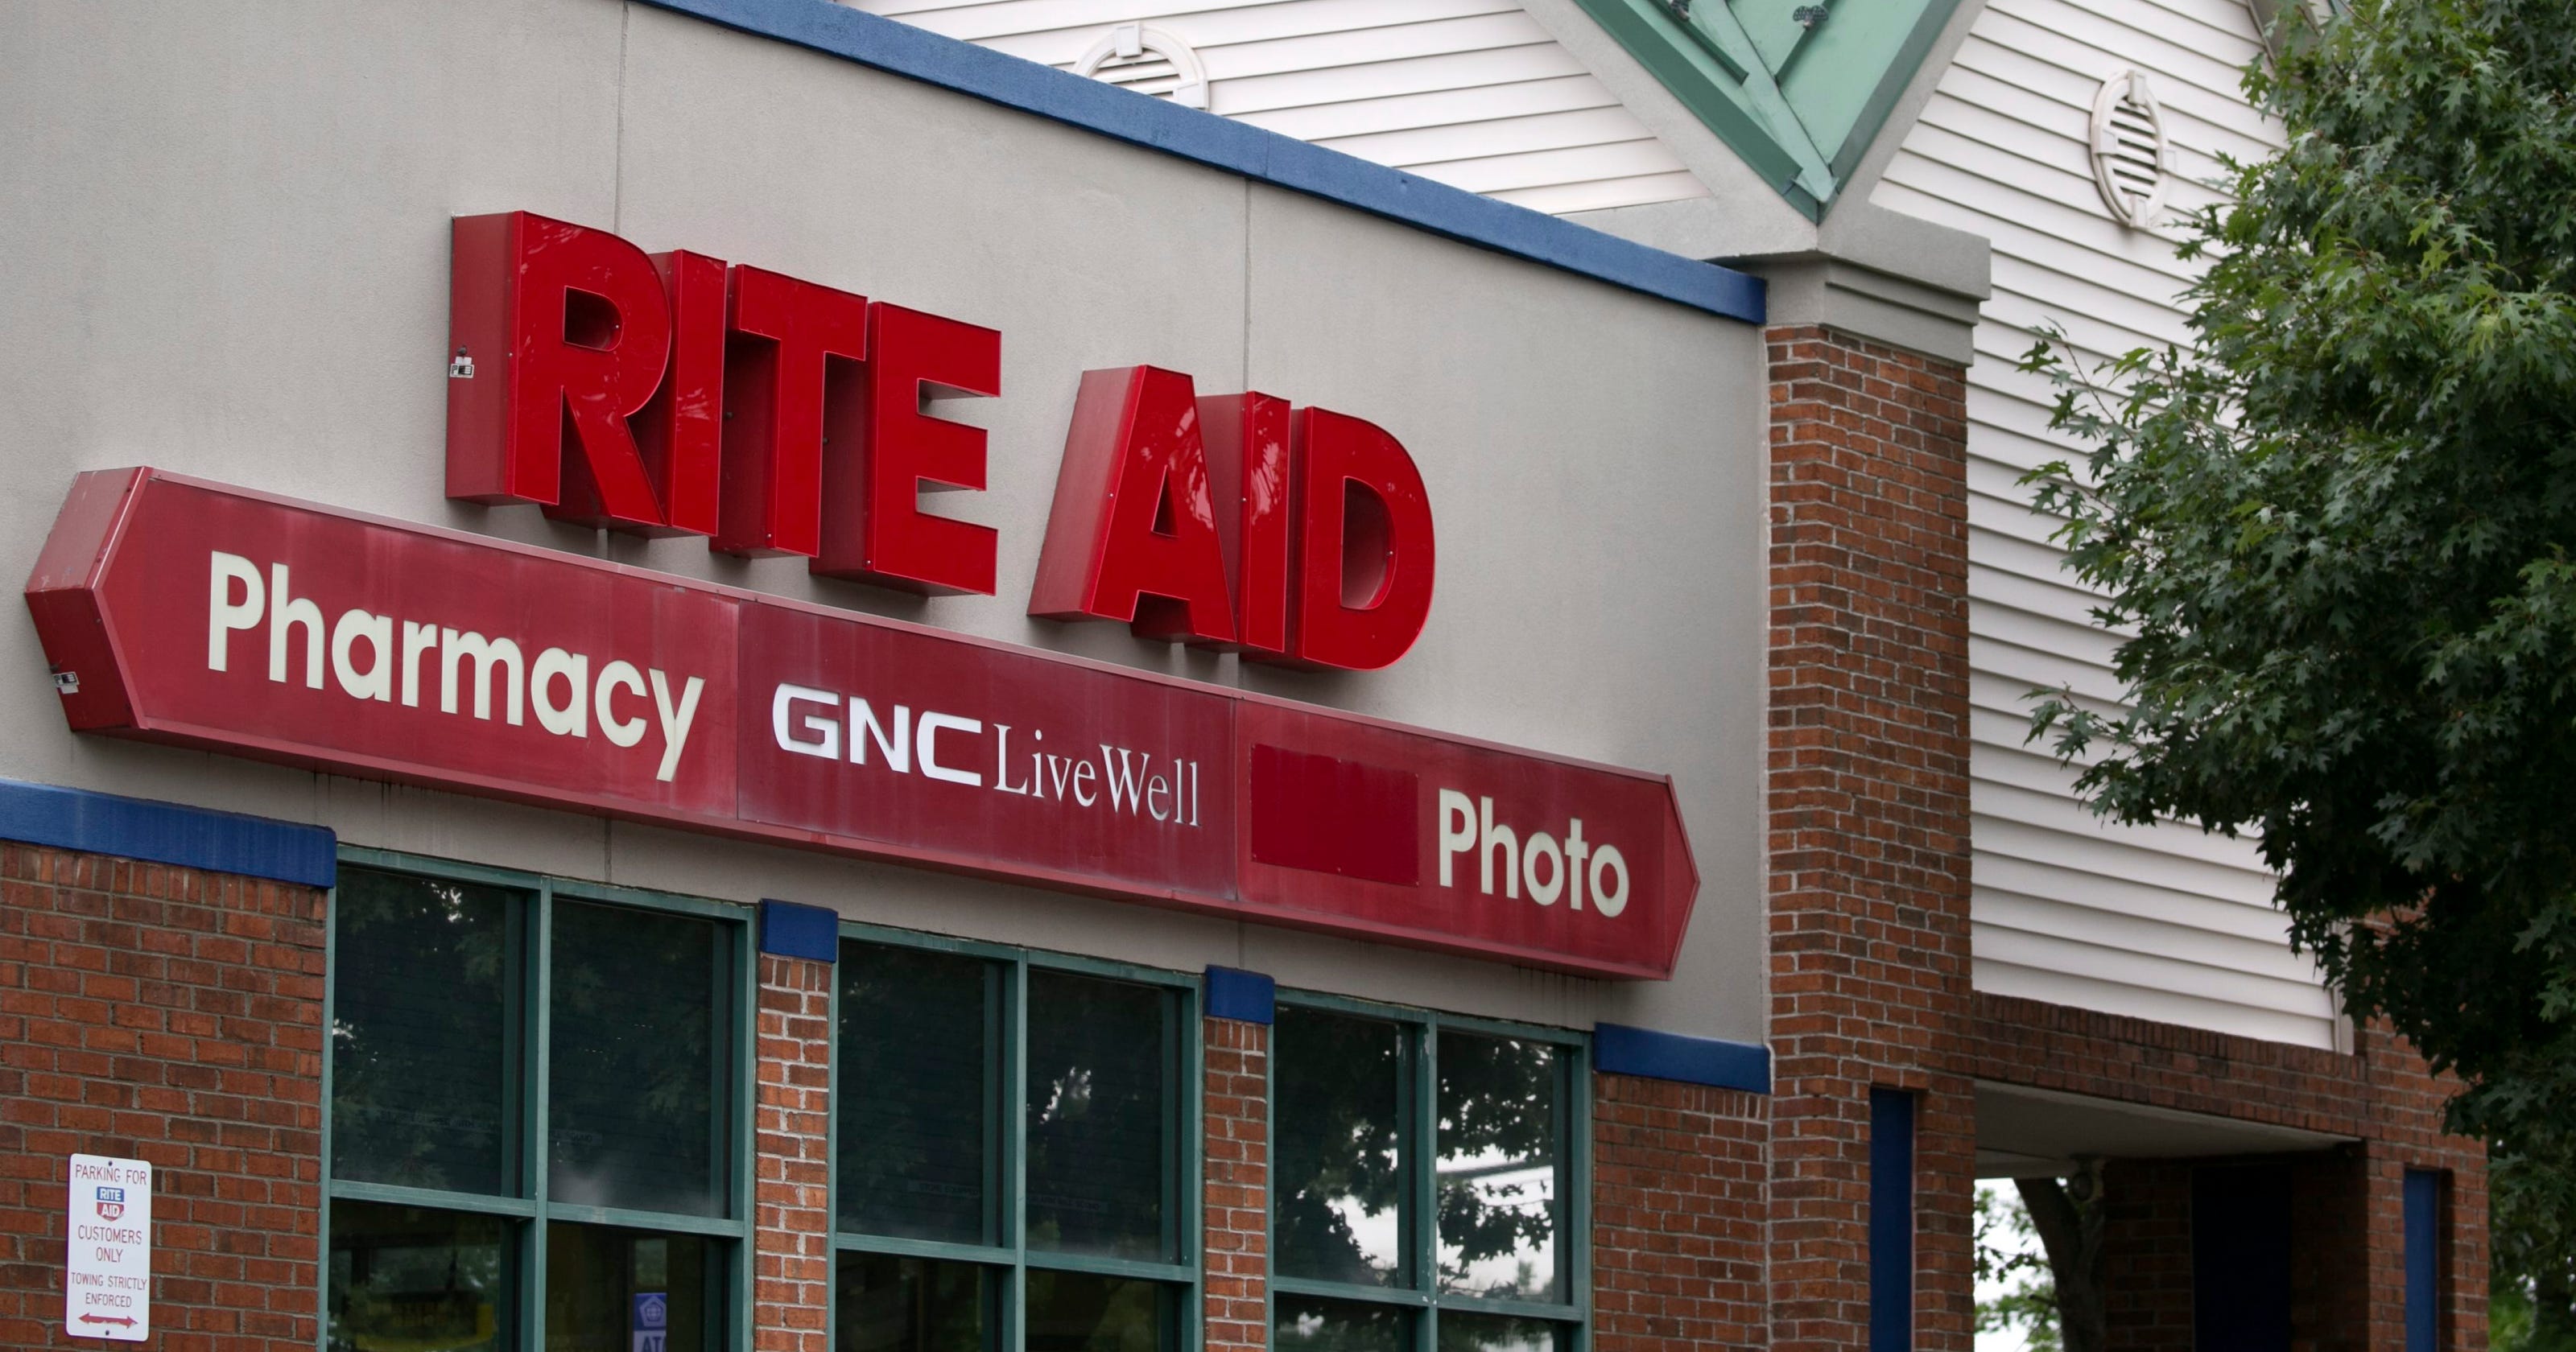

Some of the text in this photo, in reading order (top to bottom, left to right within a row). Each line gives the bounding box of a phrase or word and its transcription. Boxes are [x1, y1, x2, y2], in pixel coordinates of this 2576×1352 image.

[506, 210, 1436, 672] RITE AID
[208, 550, 705, 782] Pharmacy
[772, 682, 981, 786] GNC
[1439, 788, 1630, 917] Photo
[75, 1164, 147, 1185] PARKING FOR
[100, 1188, 122, 1202] RITE
[101, 1203, 121, 1218] AID
[78, 1225, 142, 1245] CUSTOMERS
[96, 1247, 123, 1263] ONLY
[71, 1272, 147, 1291] TOWING STRICTLY
[85, 1292, 132, 1308] ENFORCED
[641, 1336, 667, 1352] AT
